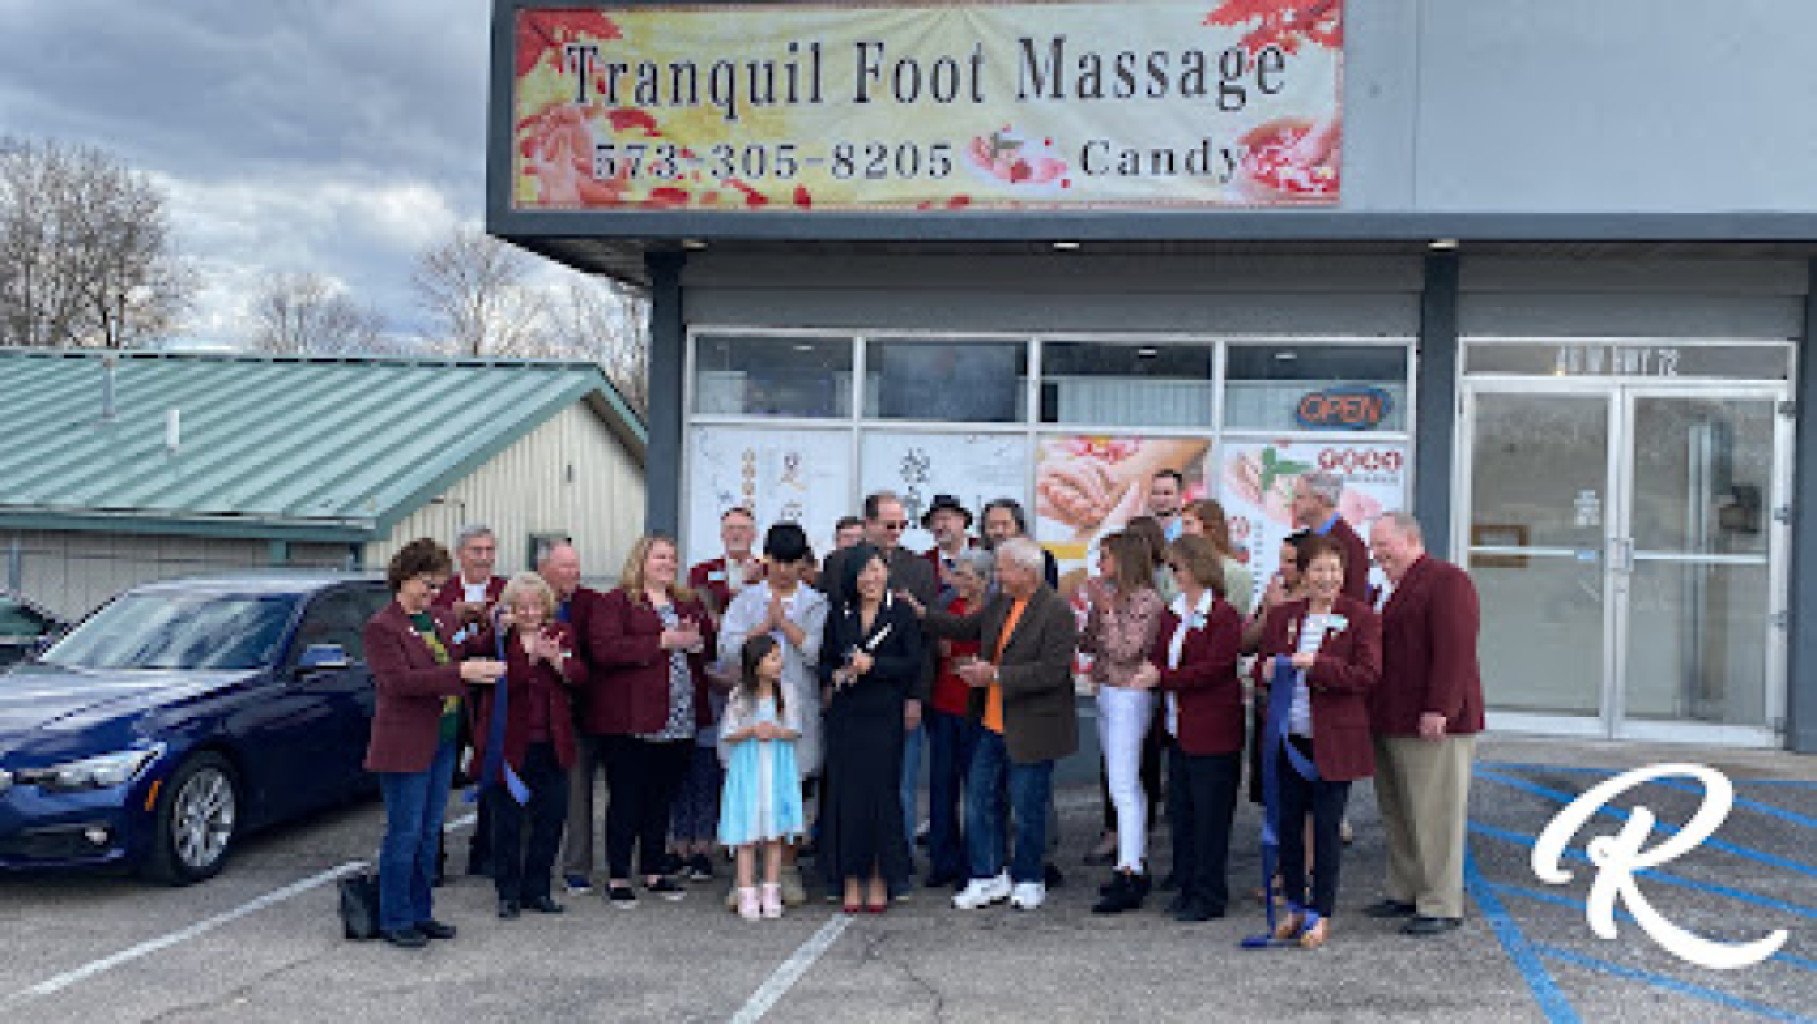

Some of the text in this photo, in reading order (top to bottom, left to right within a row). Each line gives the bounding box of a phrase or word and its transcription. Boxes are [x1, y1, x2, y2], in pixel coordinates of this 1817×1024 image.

[566, 34, 1286, 121] Tranquil Foot Massage
[595, 137, 1239, 183] 573-305-8205 Candy
[1300, 395, 1382, 424] OPEN
